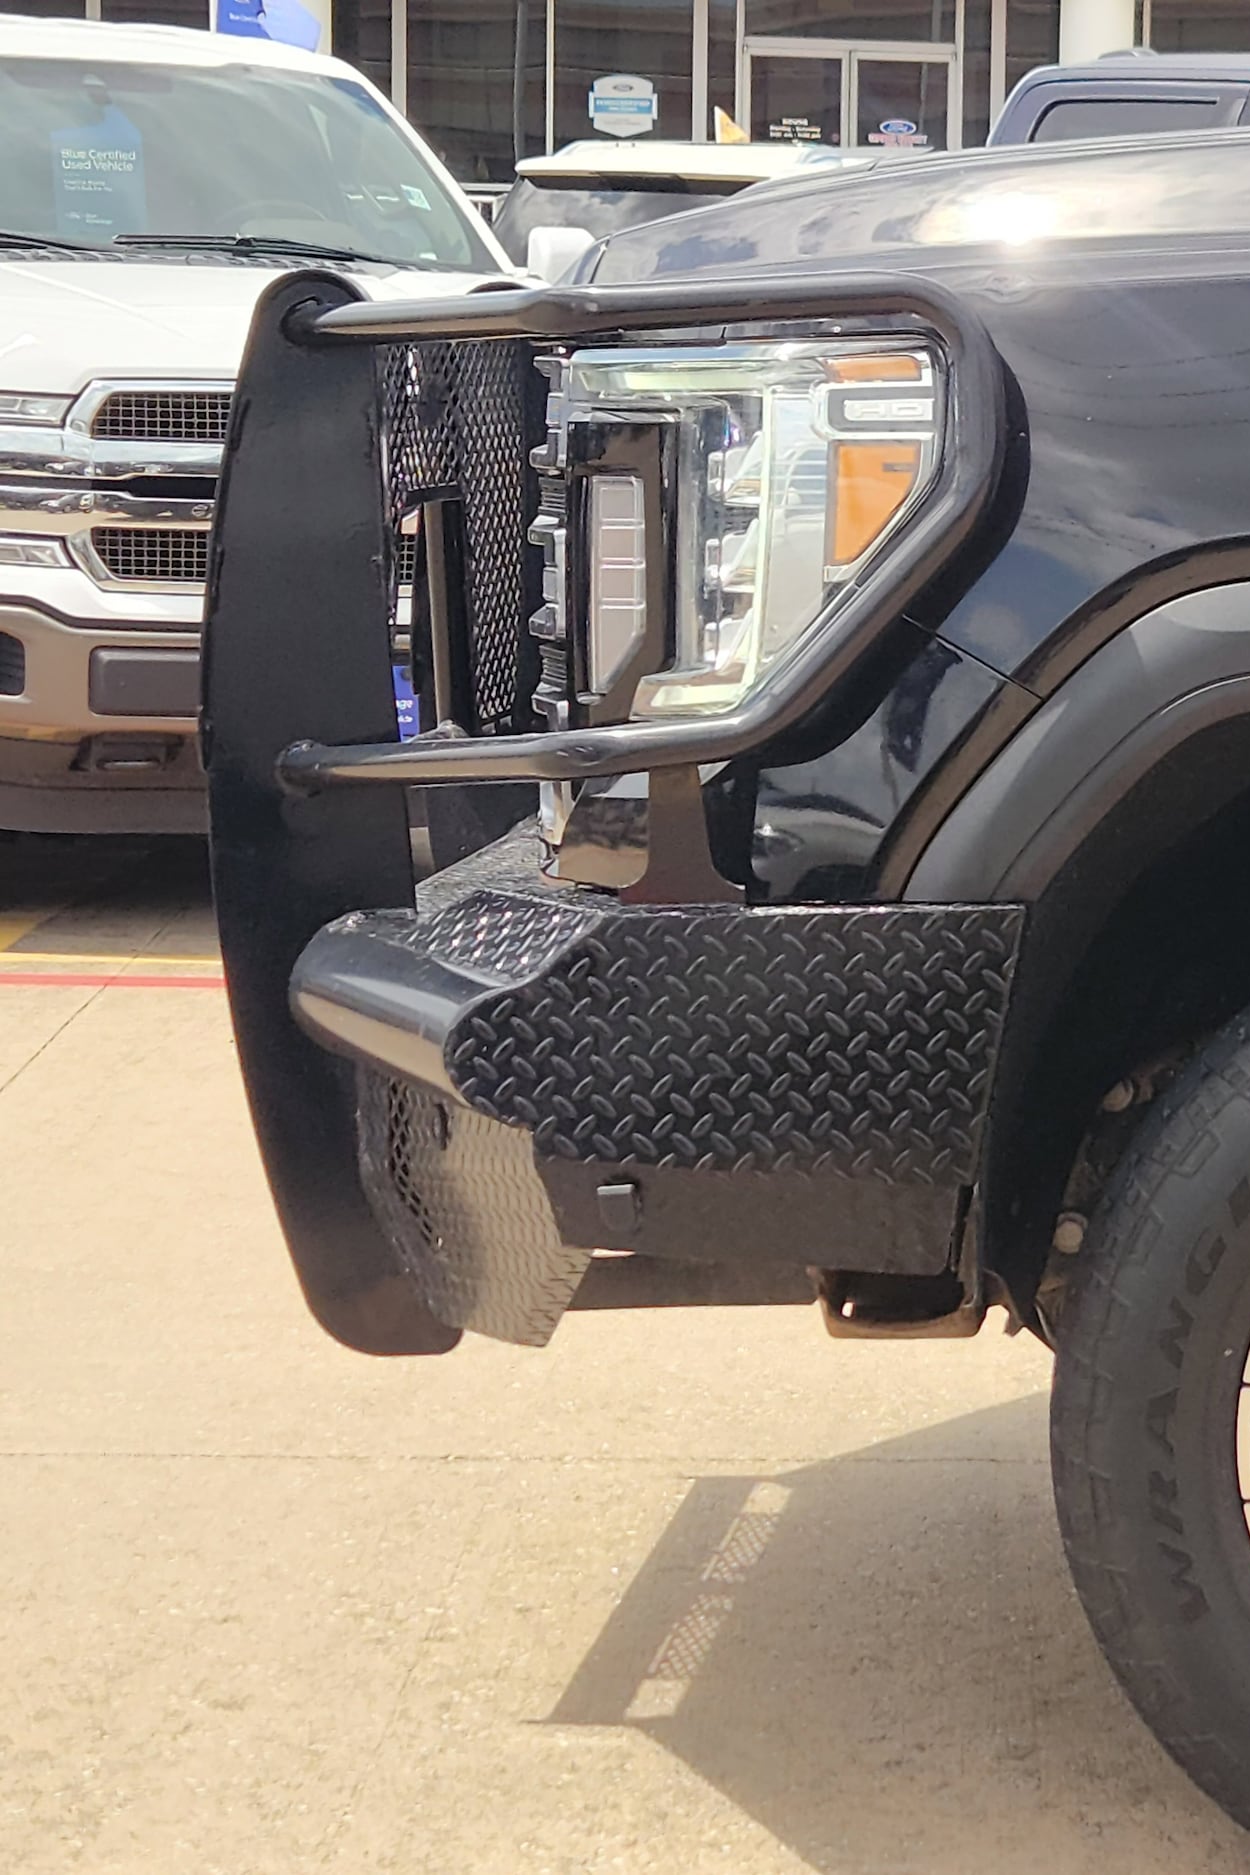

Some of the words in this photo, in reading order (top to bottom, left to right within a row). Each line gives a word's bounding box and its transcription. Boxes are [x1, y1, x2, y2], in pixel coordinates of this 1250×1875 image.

[88, 149, 136, 161] Certified
[62, 160, 91, 170] Used
[93, 160, 134, 172] Vehicle
